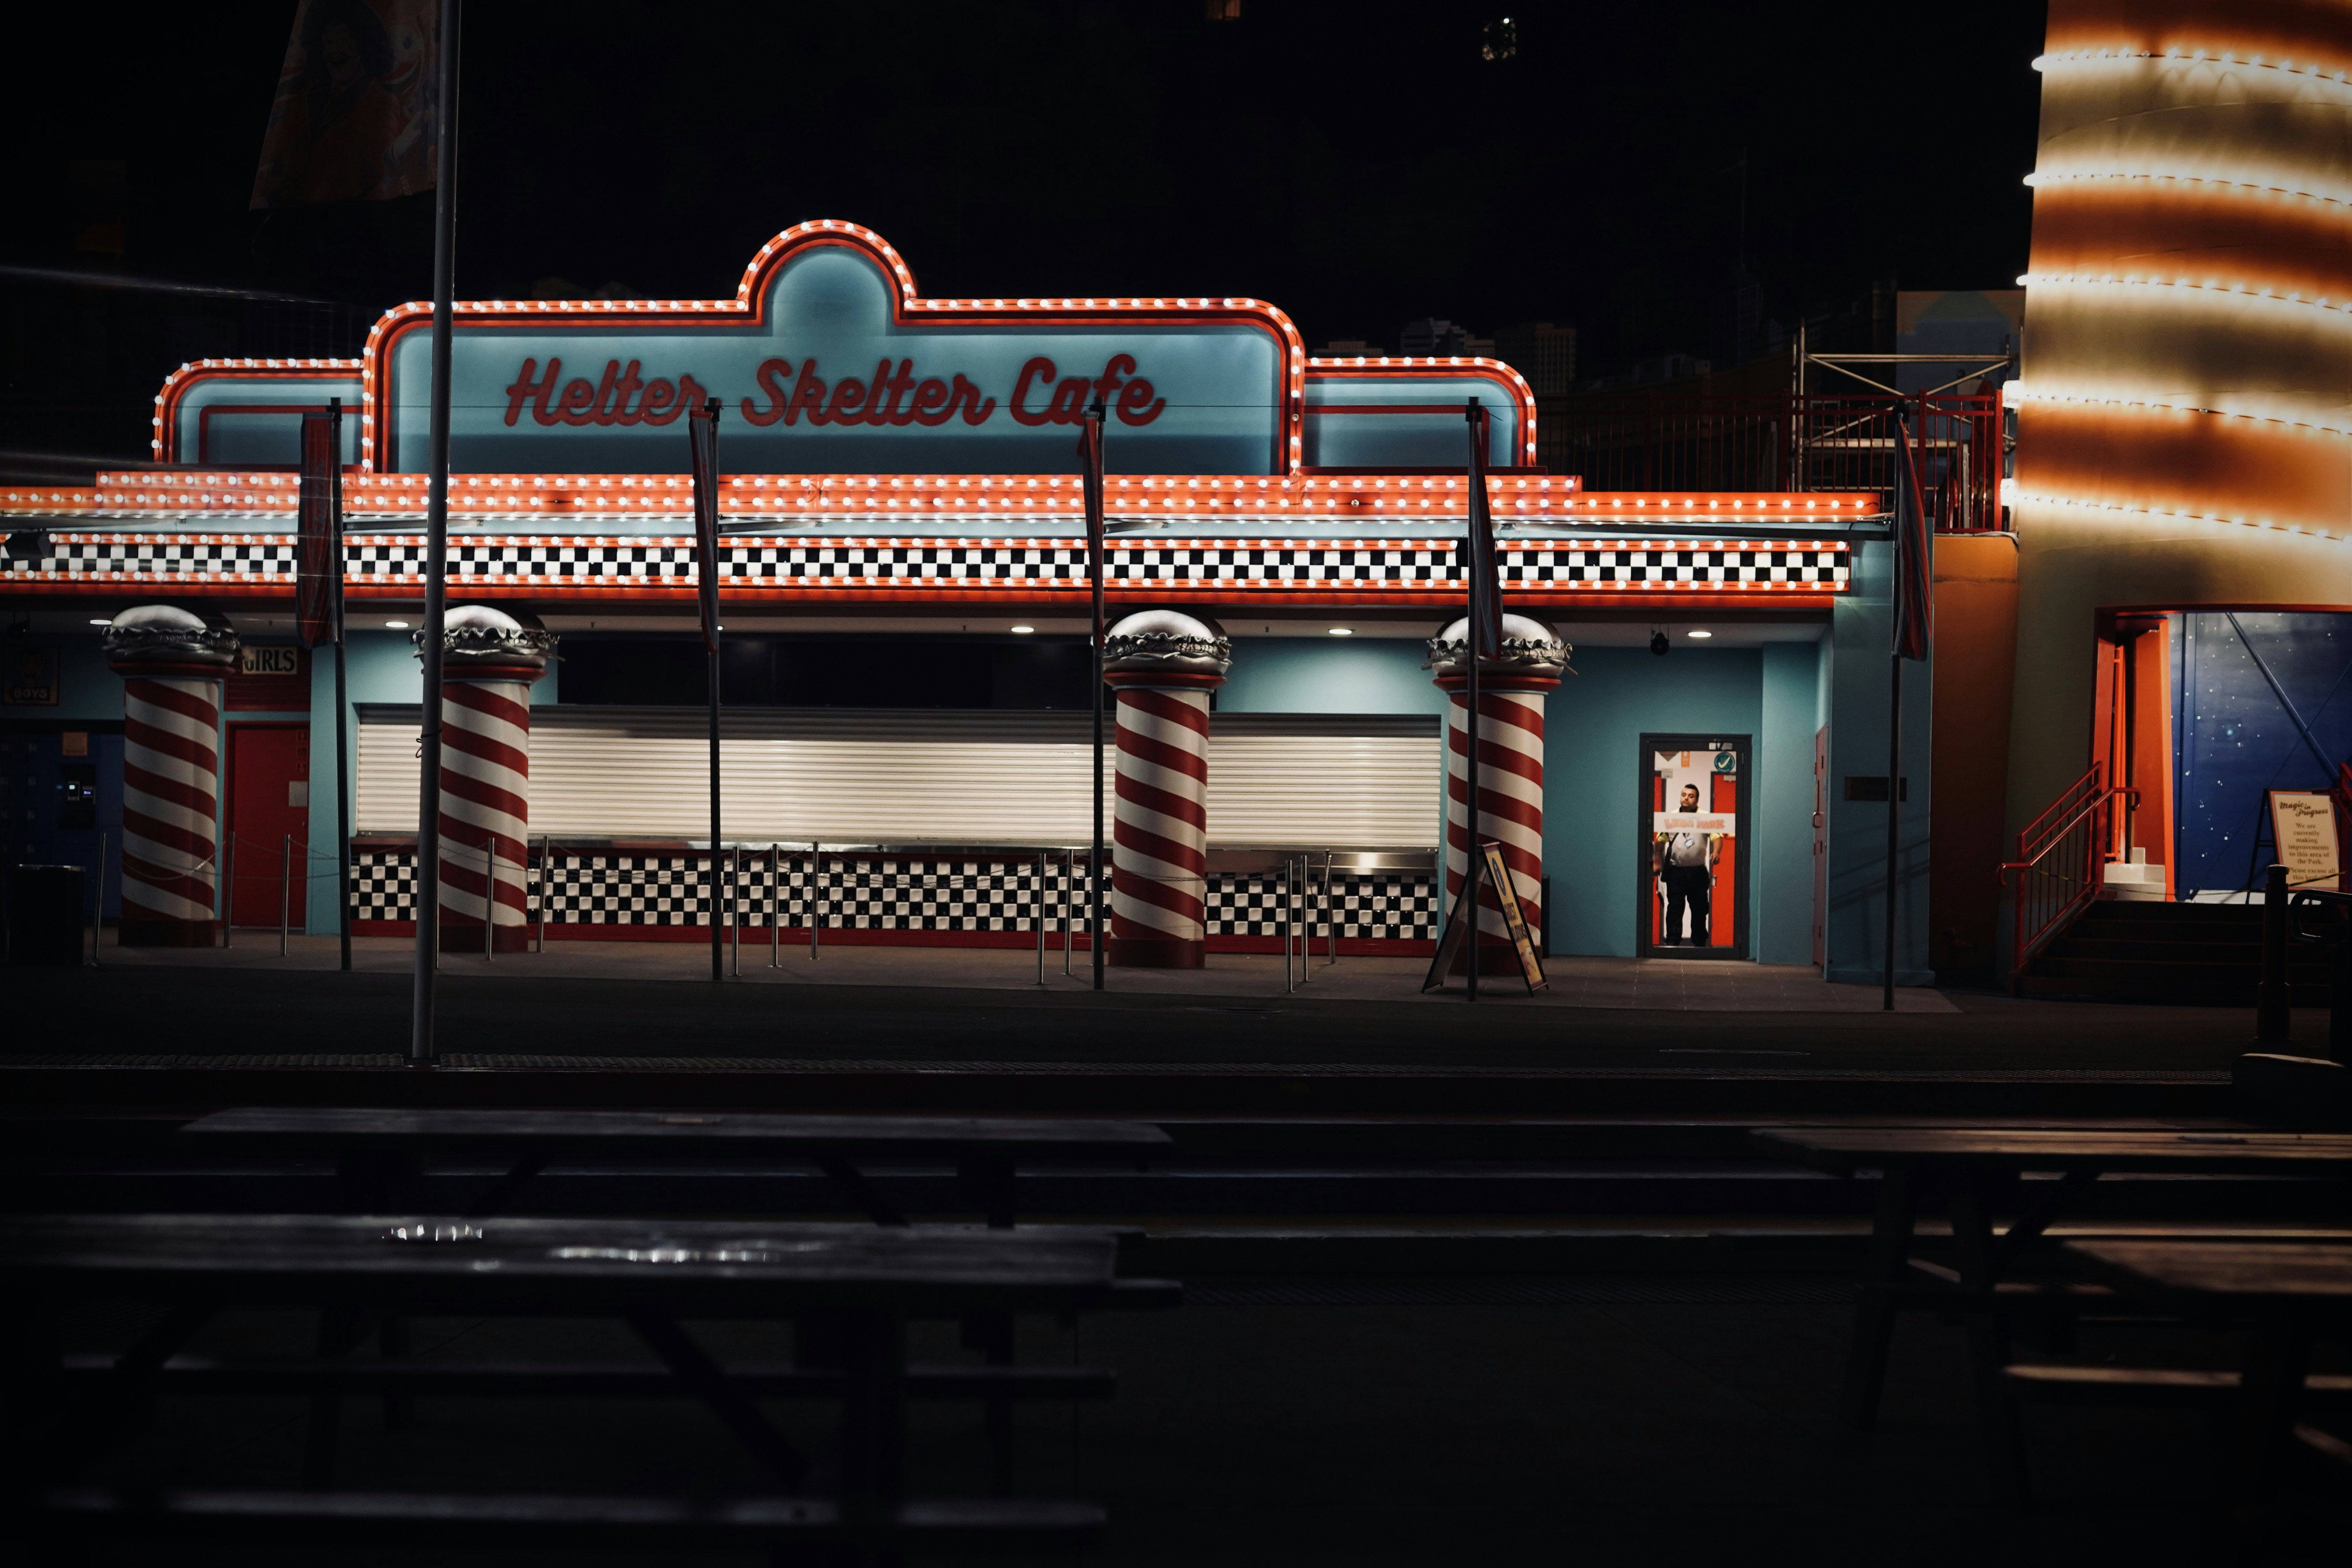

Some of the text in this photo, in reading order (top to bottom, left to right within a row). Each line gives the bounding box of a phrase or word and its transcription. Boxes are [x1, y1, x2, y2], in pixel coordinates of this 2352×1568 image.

[504, 354, 1166, 456] Helter Skelter Cafe
[14, 687, 48, 699] BOYS
[2295, 808, 2328, 818] Progress
